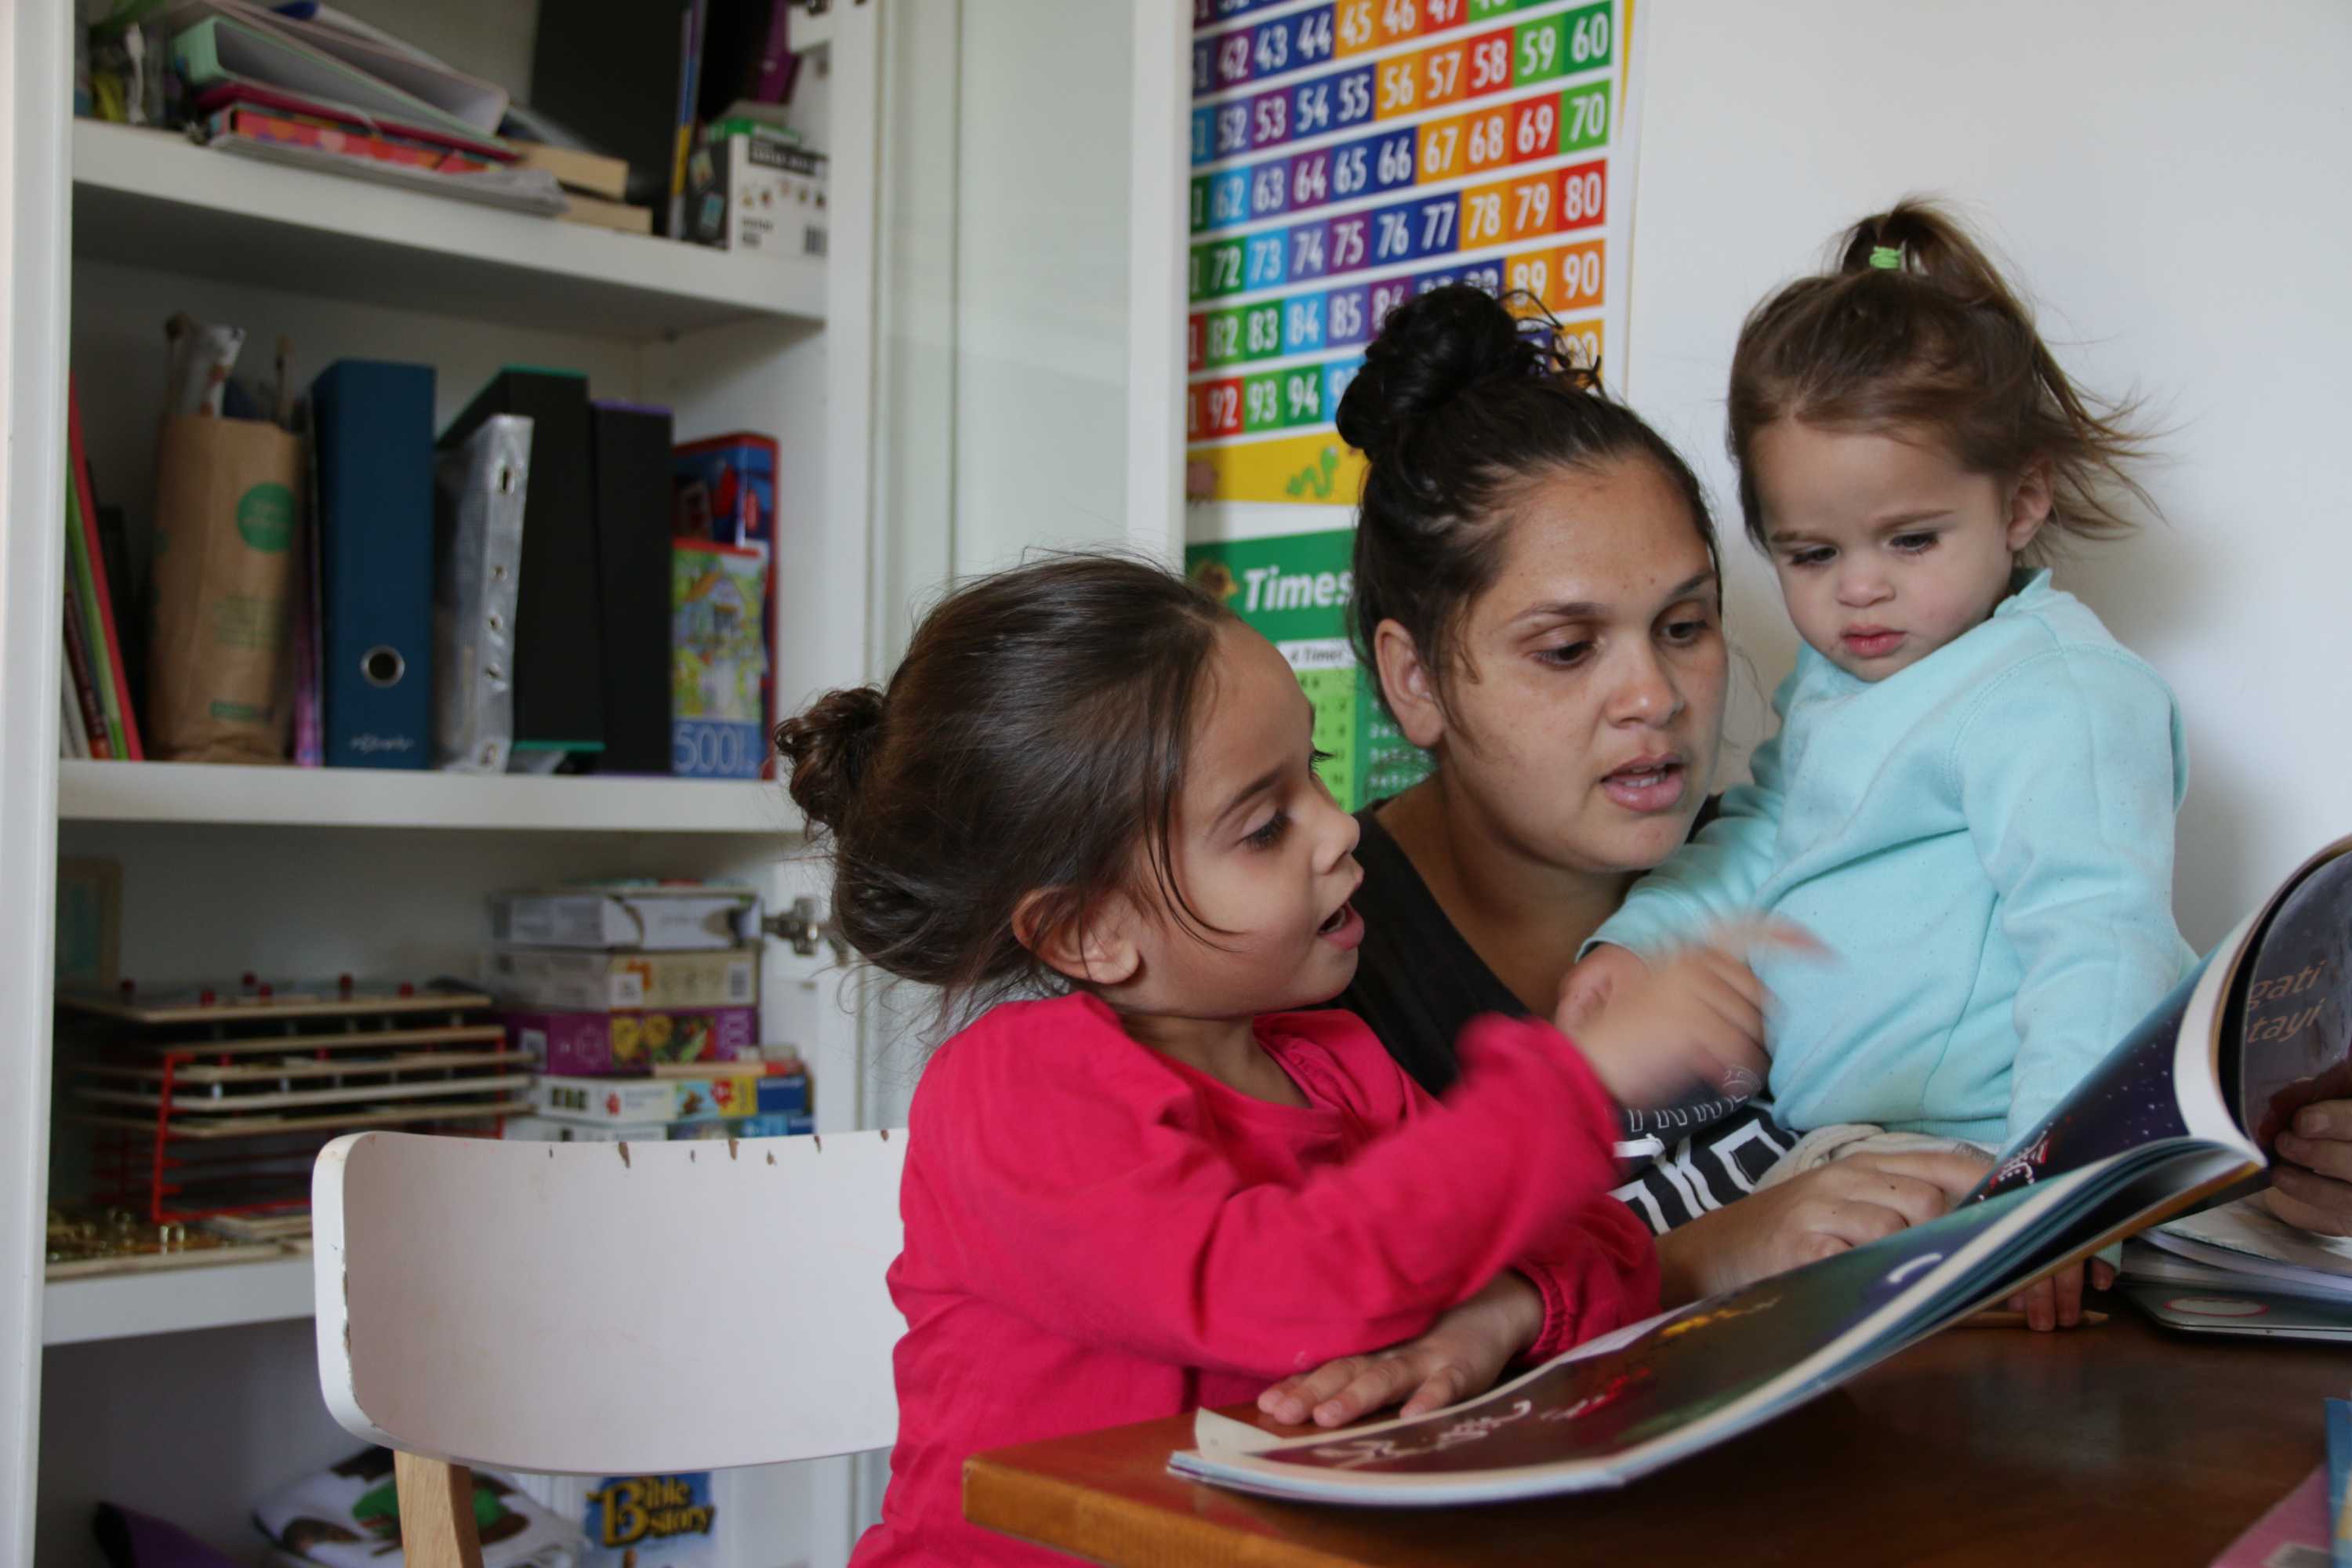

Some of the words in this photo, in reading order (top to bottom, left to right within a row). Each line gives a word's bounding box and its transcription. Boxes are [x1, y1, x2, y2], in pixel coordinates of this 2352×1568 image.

[1217, 106, 1247, 151] 52
[1254, 96, 1286, 143] 53
[1296, 84, 1330, 132] 54
[1336, 73, 1370, 122] 55
[1381, 62, 1414, 110] 56
[1427, 51, 1461, 99] 57
[1472, 39, 1508, 88] 58
[1520, 26, 1556, 76] 59
[1571, 13, 1609, 63] 60
[1220, 35, 1249, 82] 42
[1256, 24, 1288, 71] 43
[1296, 11, 1332, 60] 44
[1341, 2, 1372, 46] 45
[1382, 0, 1416, 34] 46
[1213, 176, 1245, 220] 62
[1253, 166, 1285, 212] 63
[1294, 156, 1327, 203] 64
[1334, 147, 1367, 194] 65
[1377, 136, 1412, 185] 66
[1424, 125, 1459, 174] 67
[1468, 115, 1504, 164] 68
[1517, 104, 1554, 154] 69
[1570, 92, 1606, 143] 70
[1211, 246, 1241, 291] 72
[1251, 238, 1282, 283] 73
[1294, 228, 1324, 274] 74
[1334, 220, 1364, 267] 75
[1377, 211, 1410, 259] 76
[1421, 201, 1457, 250] 77
[1468, 192, 1501, 241] 78
[1515, 182, 1550, 232] 79
[1563, 171, 1602, 222] 80
[1210, 317, 1239, 360] 82
[1248, 307, 1279, 353] 83
[1287, 299, 1320, 347] 84
[1329, 292, 1363, 339] 85
[1512, 260, 1548, 306] 89
[1563, 251, 1600, 299] 90
[1208, 385, 1238, 430] 92
[1248, 379, 1277, 424] 93
[1287, 372, 1319, 419] 94
[1243, 564, 1354, 612] Times
